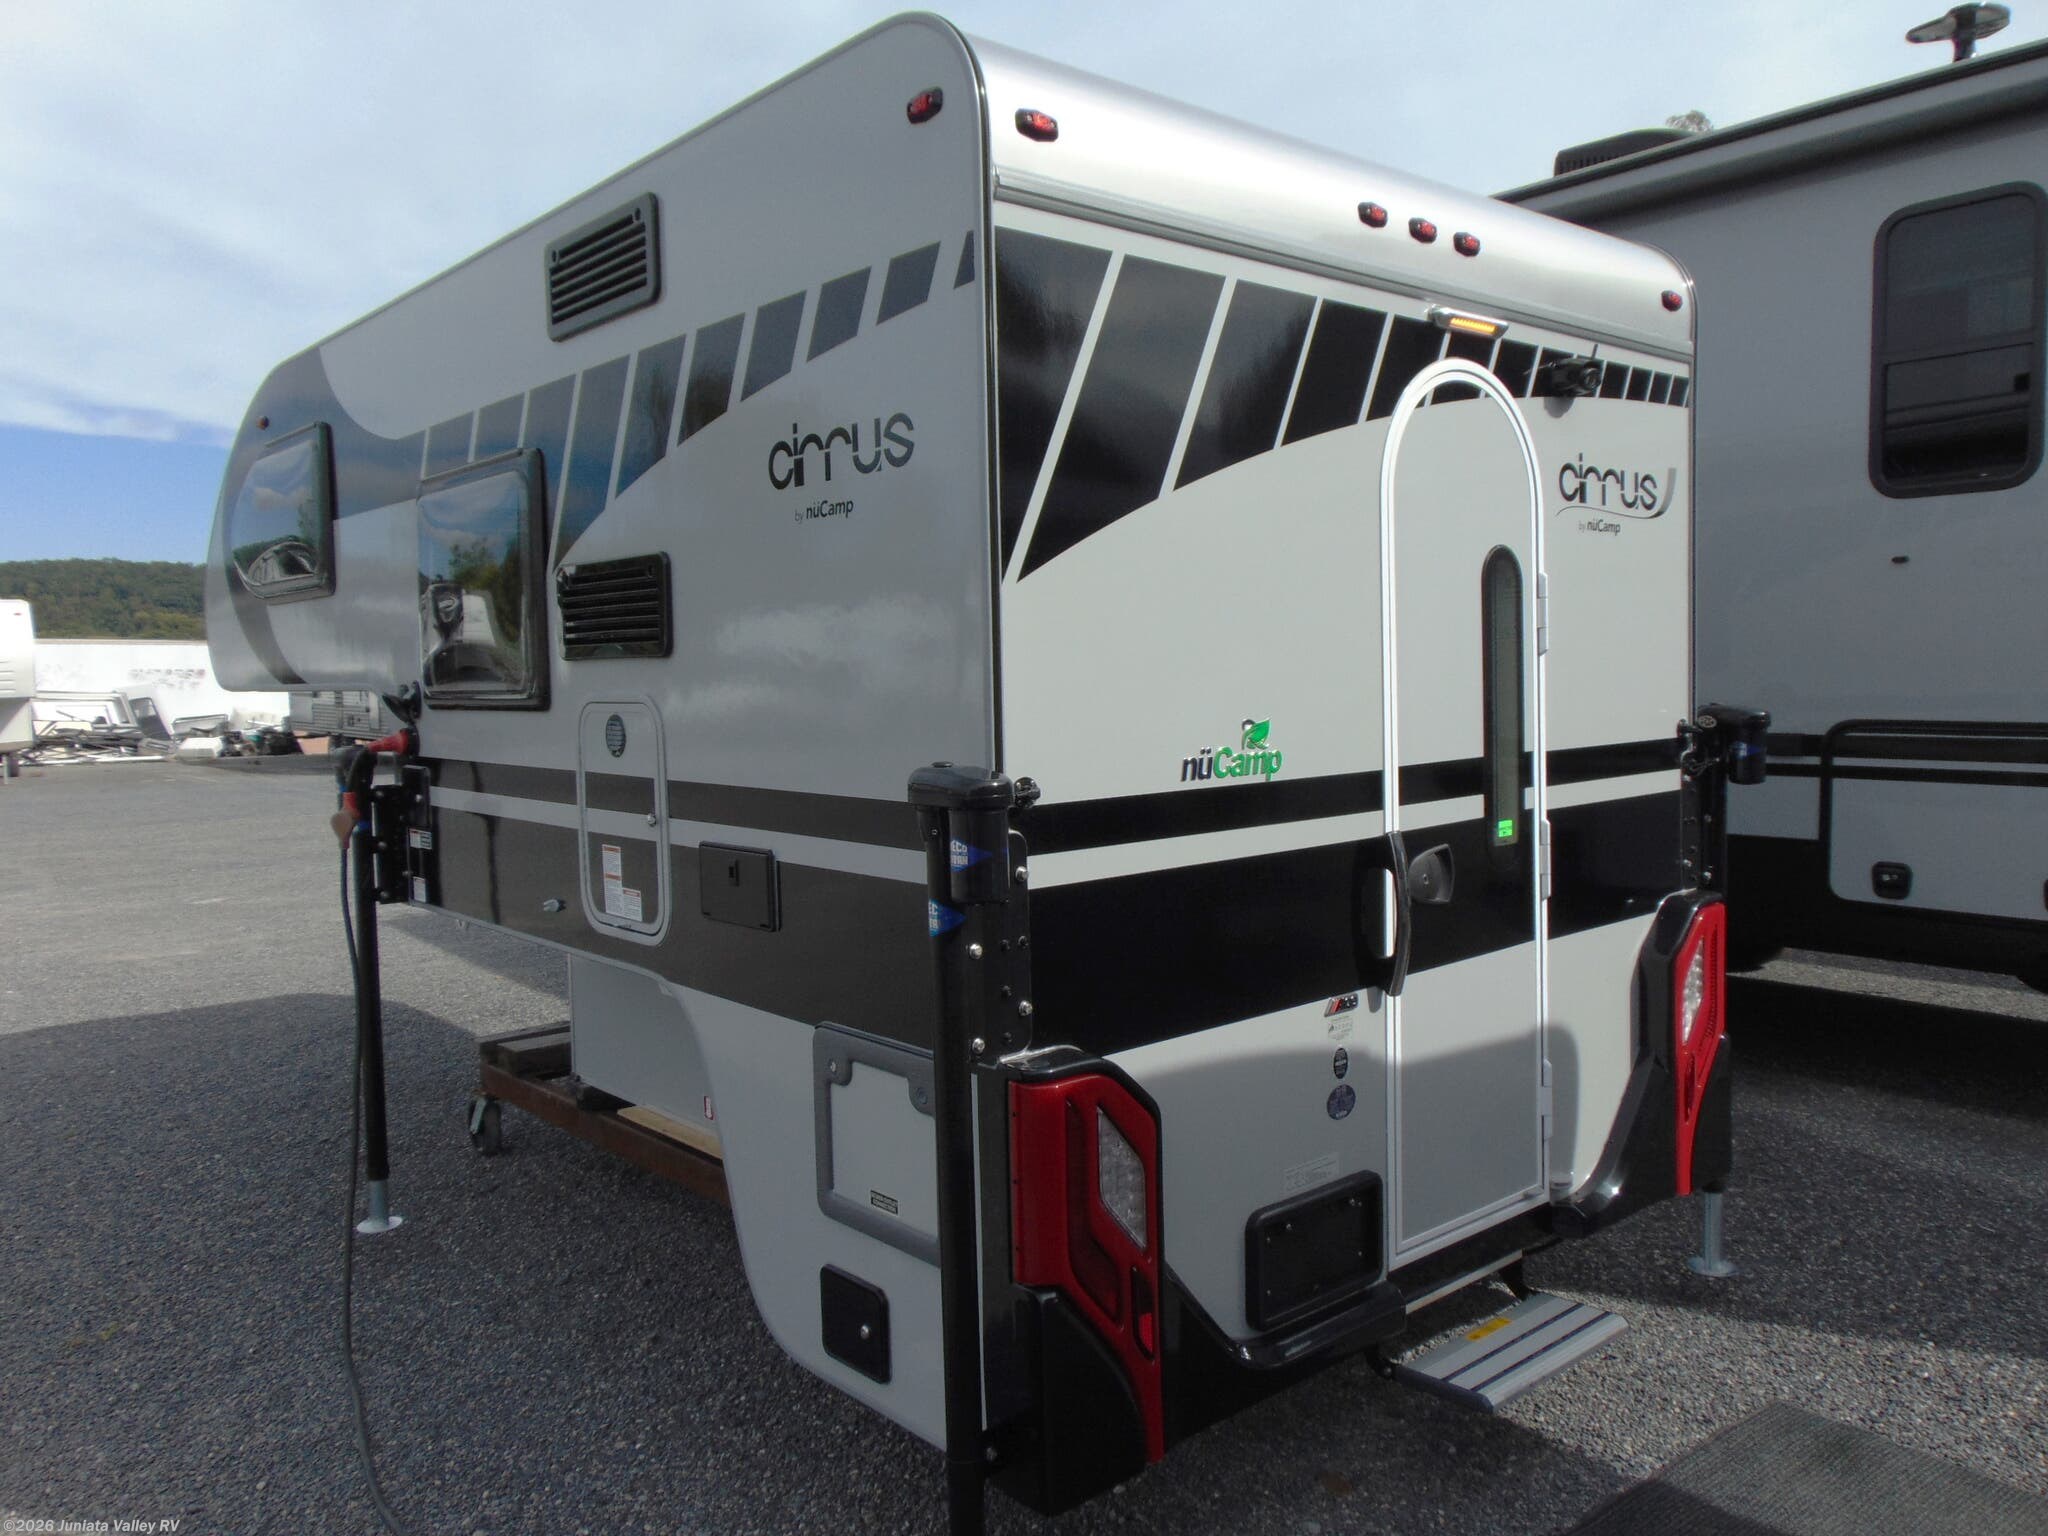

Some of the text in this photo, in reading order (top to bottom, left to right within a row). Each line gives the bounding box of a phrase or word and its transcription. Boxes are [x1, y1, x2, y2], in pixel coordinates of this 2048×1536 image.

[768, 412, 915, 490] cirrus
[1559, 452, 1657, 511] cirrus
[1181, 747, 1282, 781] nüCamp
